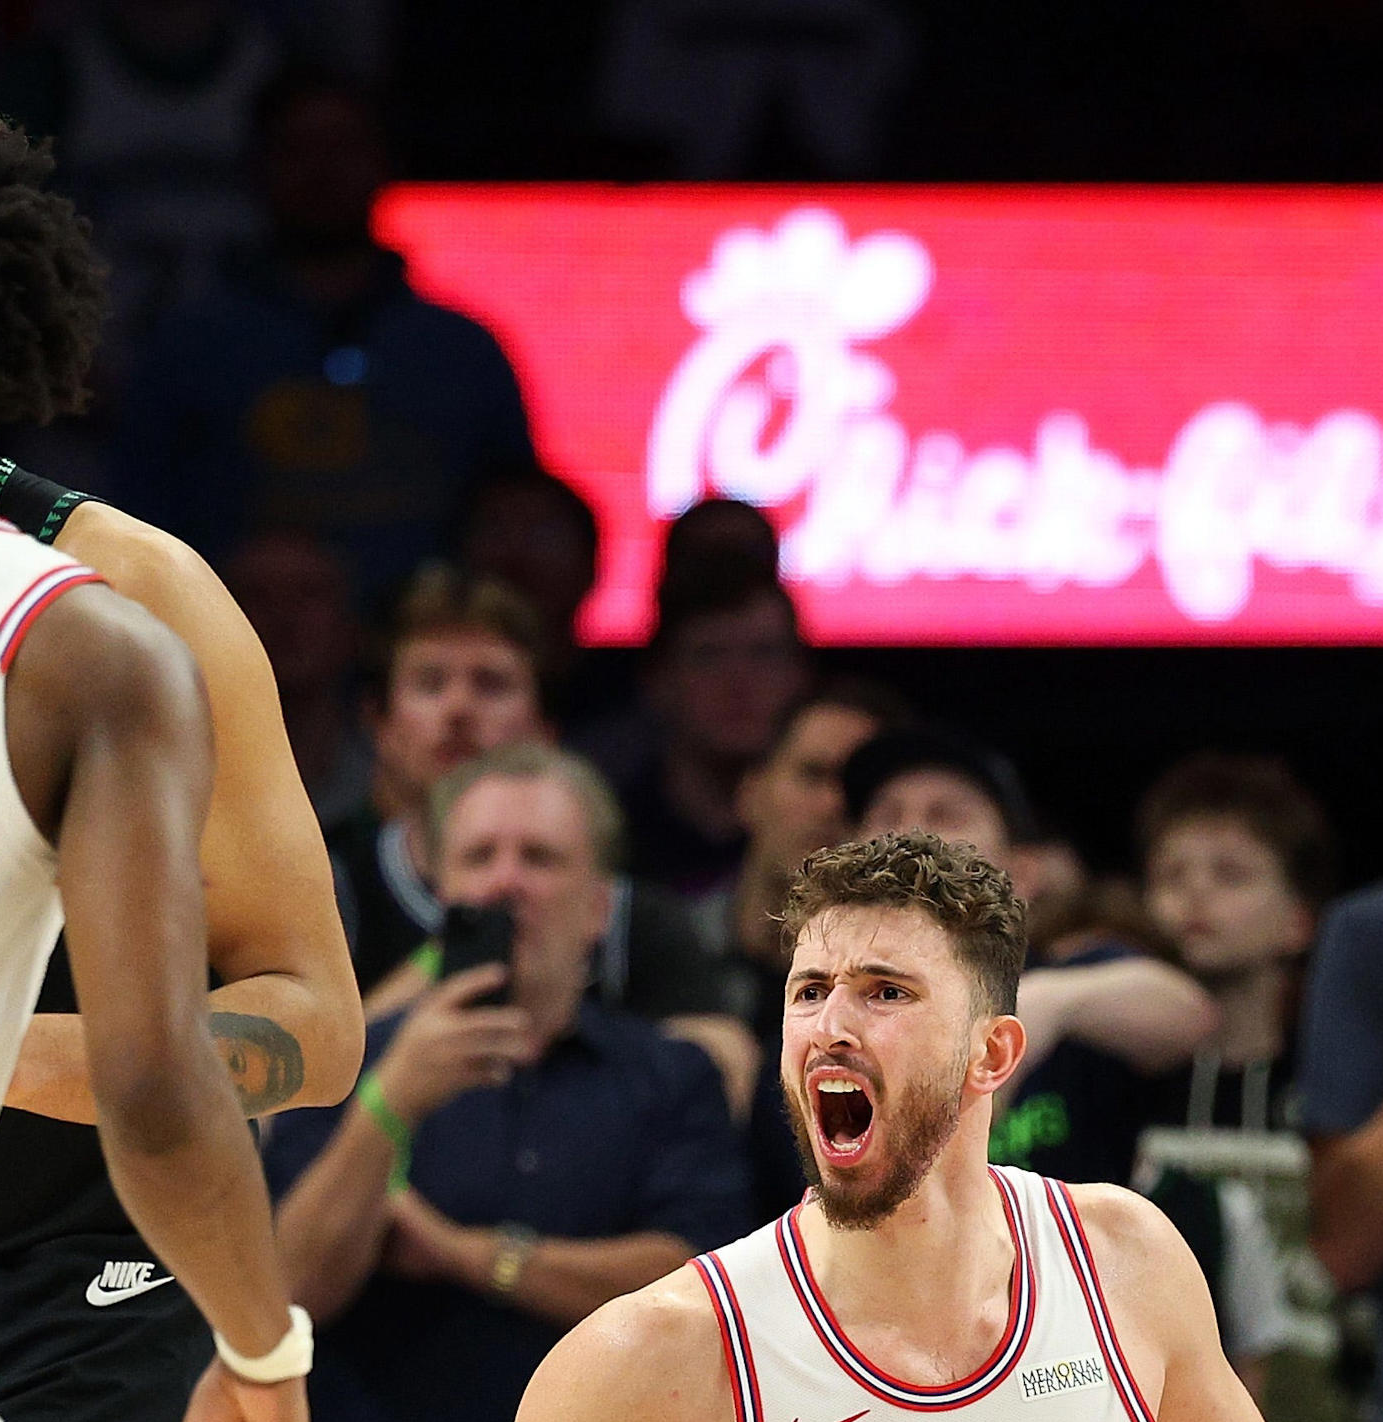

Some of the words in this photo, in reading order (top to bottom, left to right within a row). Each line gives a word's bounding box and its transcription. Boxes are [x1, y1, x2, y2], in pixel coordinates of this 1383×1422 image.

[100, 1261, 155, 1289] NIKE
[1022, 1357, 1102, 1387] MEMORIAL
[1024, 1367, 1104, 1397] HERMANN
